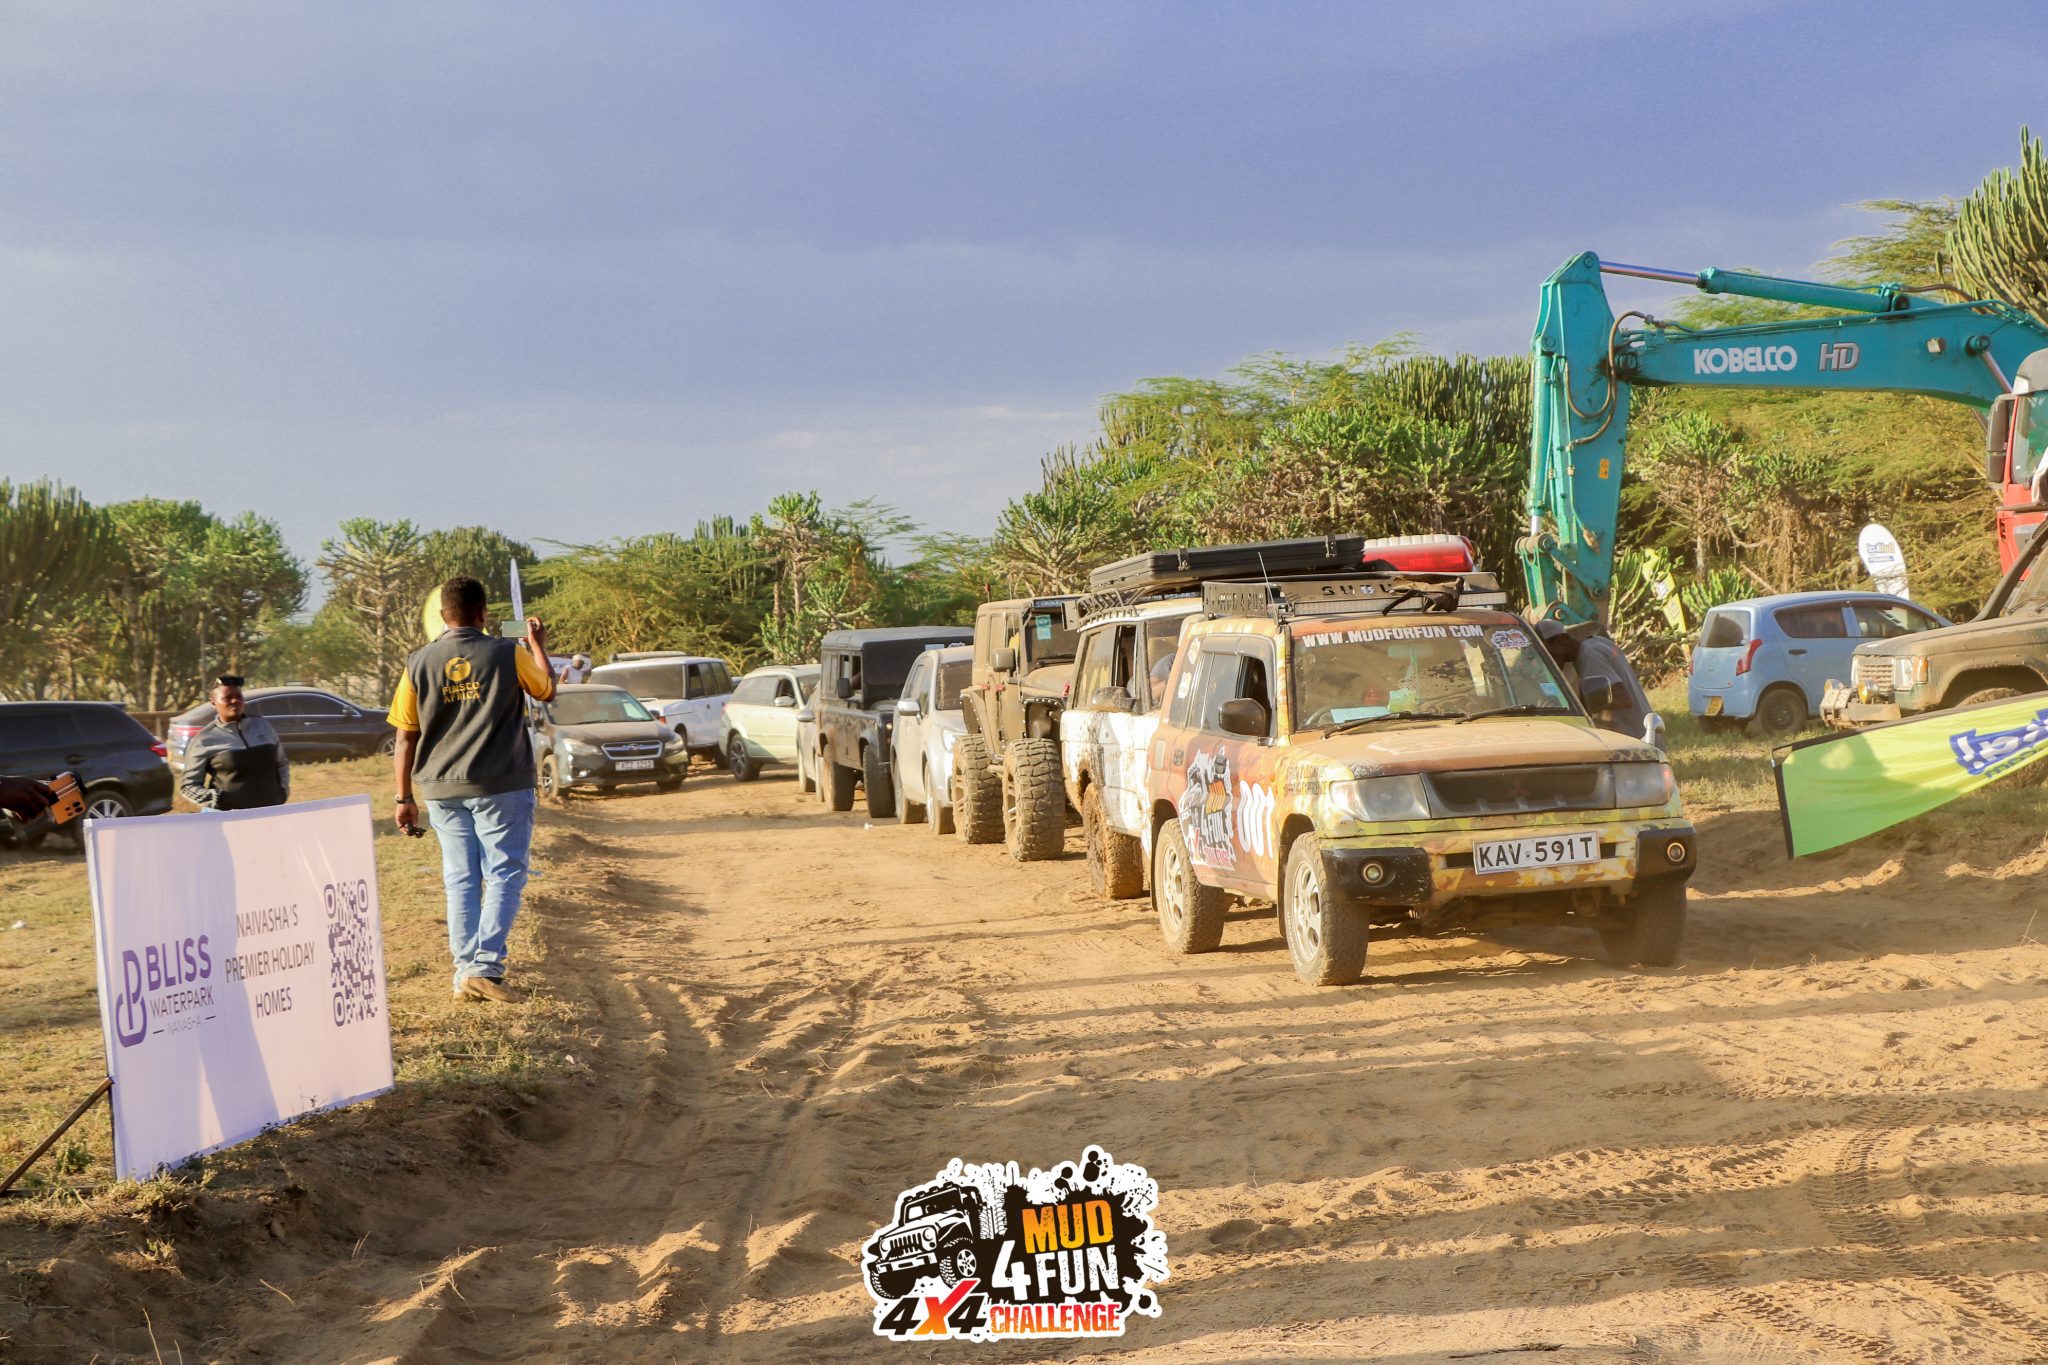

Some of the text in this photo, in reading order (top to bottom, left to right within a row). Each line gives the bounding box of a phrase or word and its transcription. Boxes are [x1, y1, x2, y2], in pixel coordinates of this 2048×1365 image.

[1693, 342, 1861, 374] KOBELCO HD
[443, 690, 480, 703] AFRICA
[1237, 780, 1275, 858] 001
[1479, 836, 1592, 868] KAV 591T
[146, 934, 212, 991] BLISS
[225, 941, 315, 983] PREMIER HOLIDAY
[150, 985, 215, 1018] WATERPARK
[255, 987, 293, 1018] HOMES
